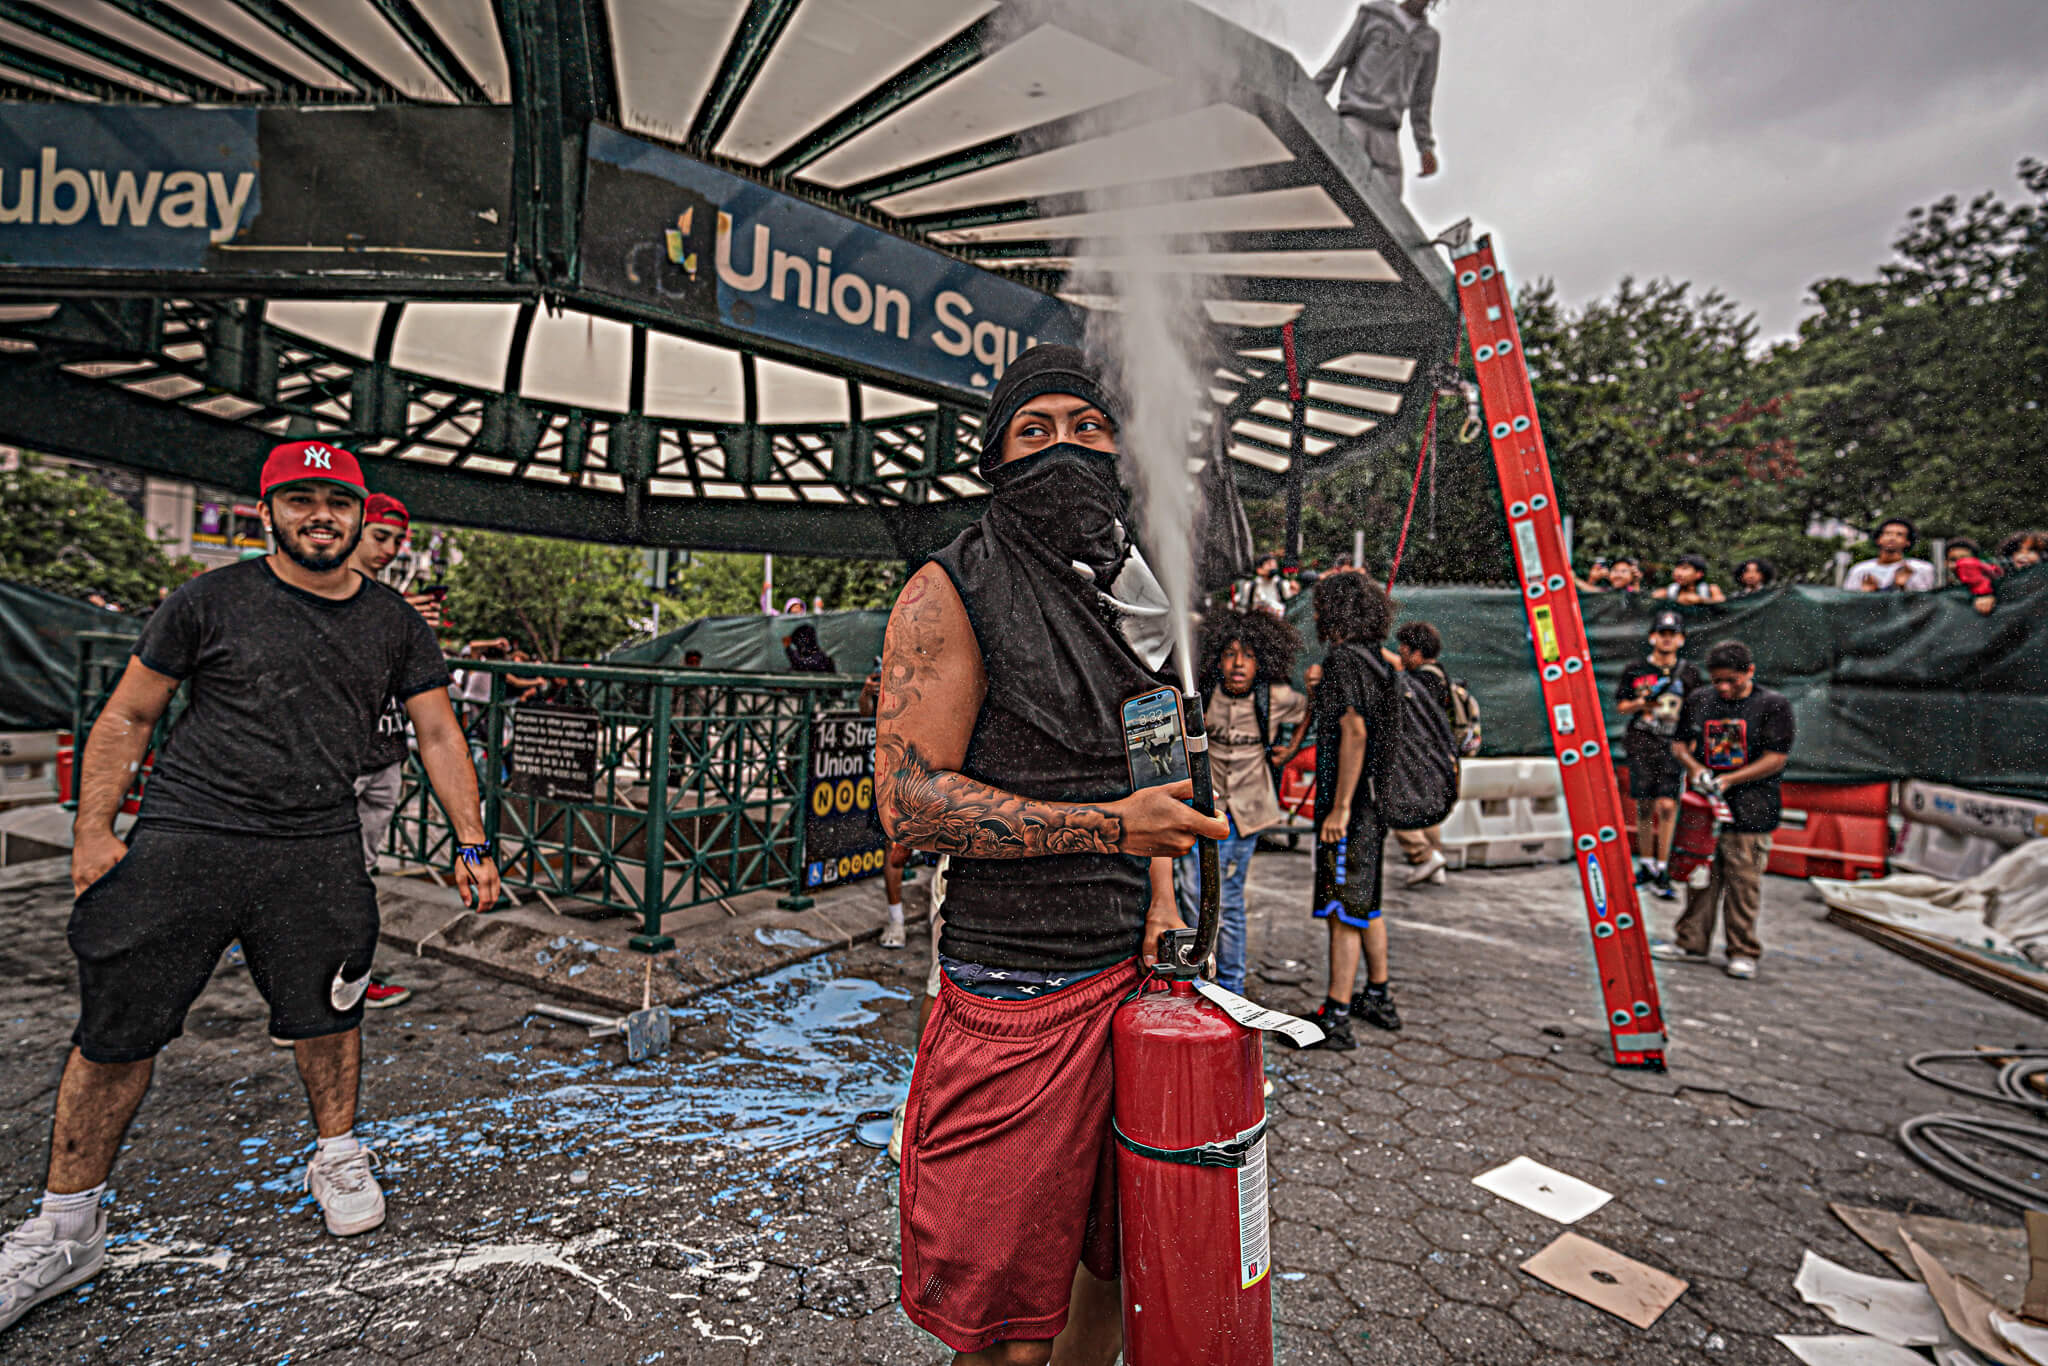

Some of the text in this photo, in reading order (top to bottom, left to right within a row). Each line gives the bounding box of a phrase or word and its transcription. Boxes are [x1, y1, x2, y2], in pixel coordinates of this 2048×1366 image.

[0, 147, 254, 243] ubway
[715, 210, 1038, 384] Union Squ
[1139, 709, 1165, 726] 3:32
[817, 721, 877, 748] 14 Stre
[816, 750, 863, 778] Union
